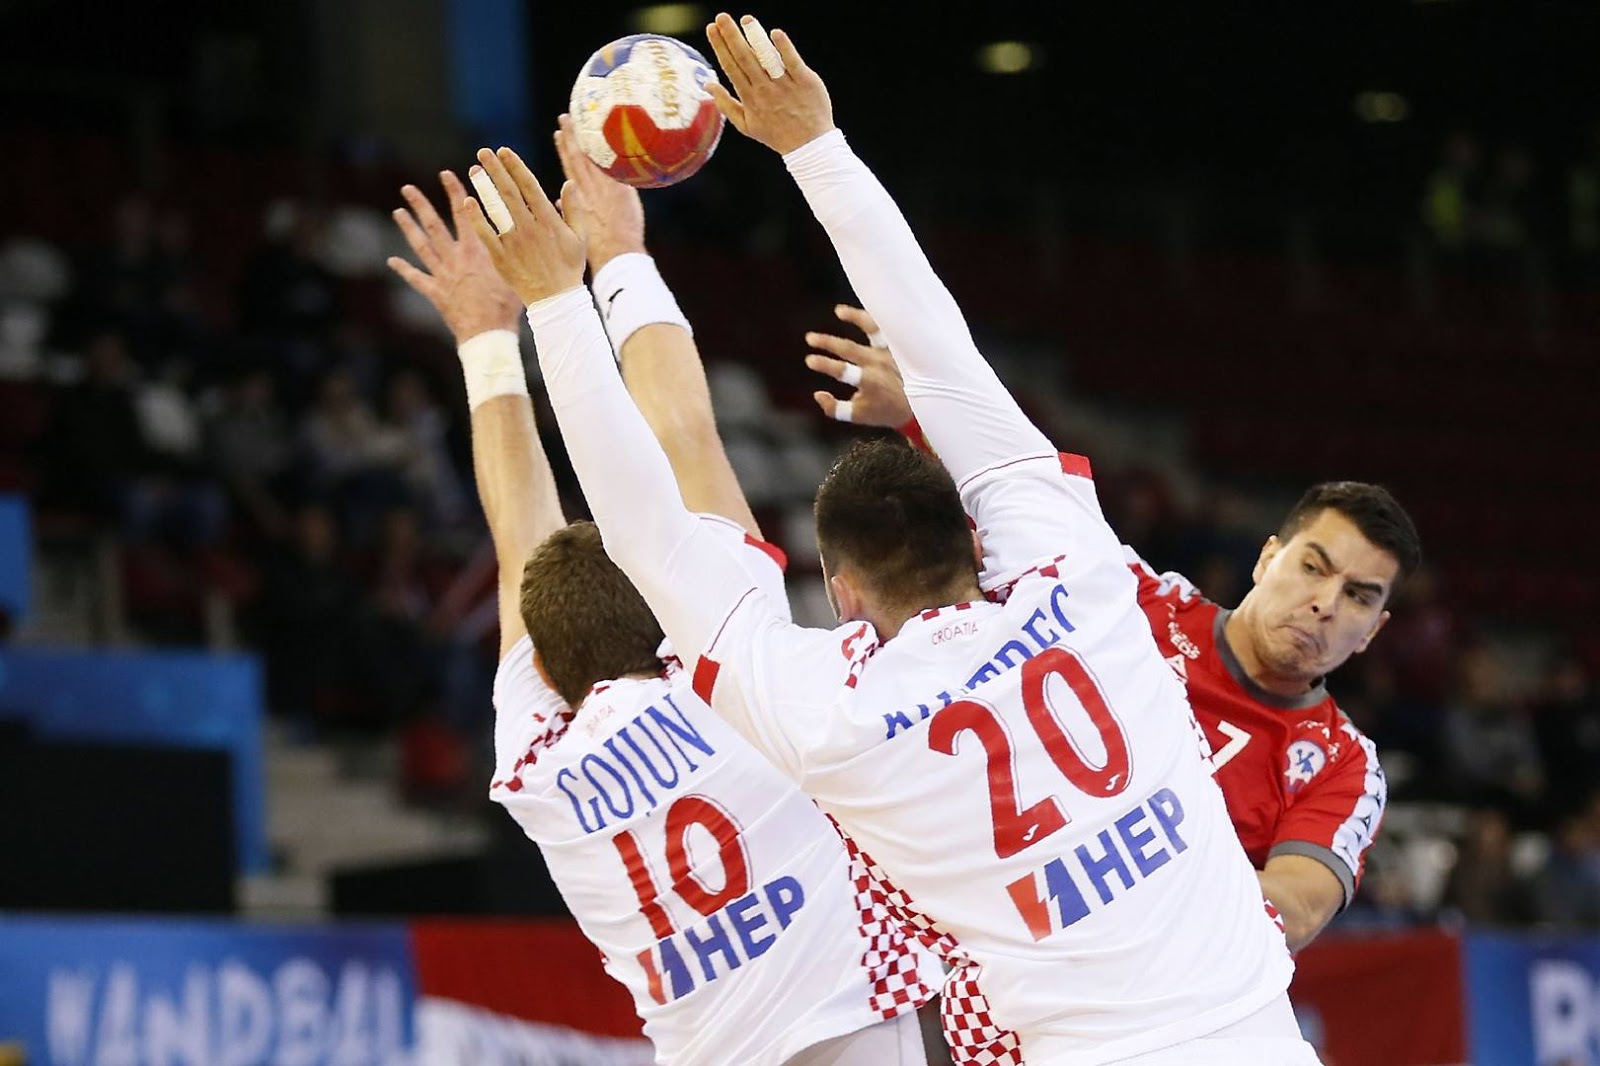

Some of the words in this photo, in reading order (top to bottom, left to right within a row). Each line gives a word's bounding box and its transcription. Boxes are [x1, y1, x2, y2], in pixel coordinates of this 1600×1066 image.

[931, 621, 979, 645] CROATIA
[927, 643, 1134, 860] 20
[612, 793, 755, 940] 10
[1074, 787, 1189, 906] HEP
[684, 875, 806, 983] HEP
